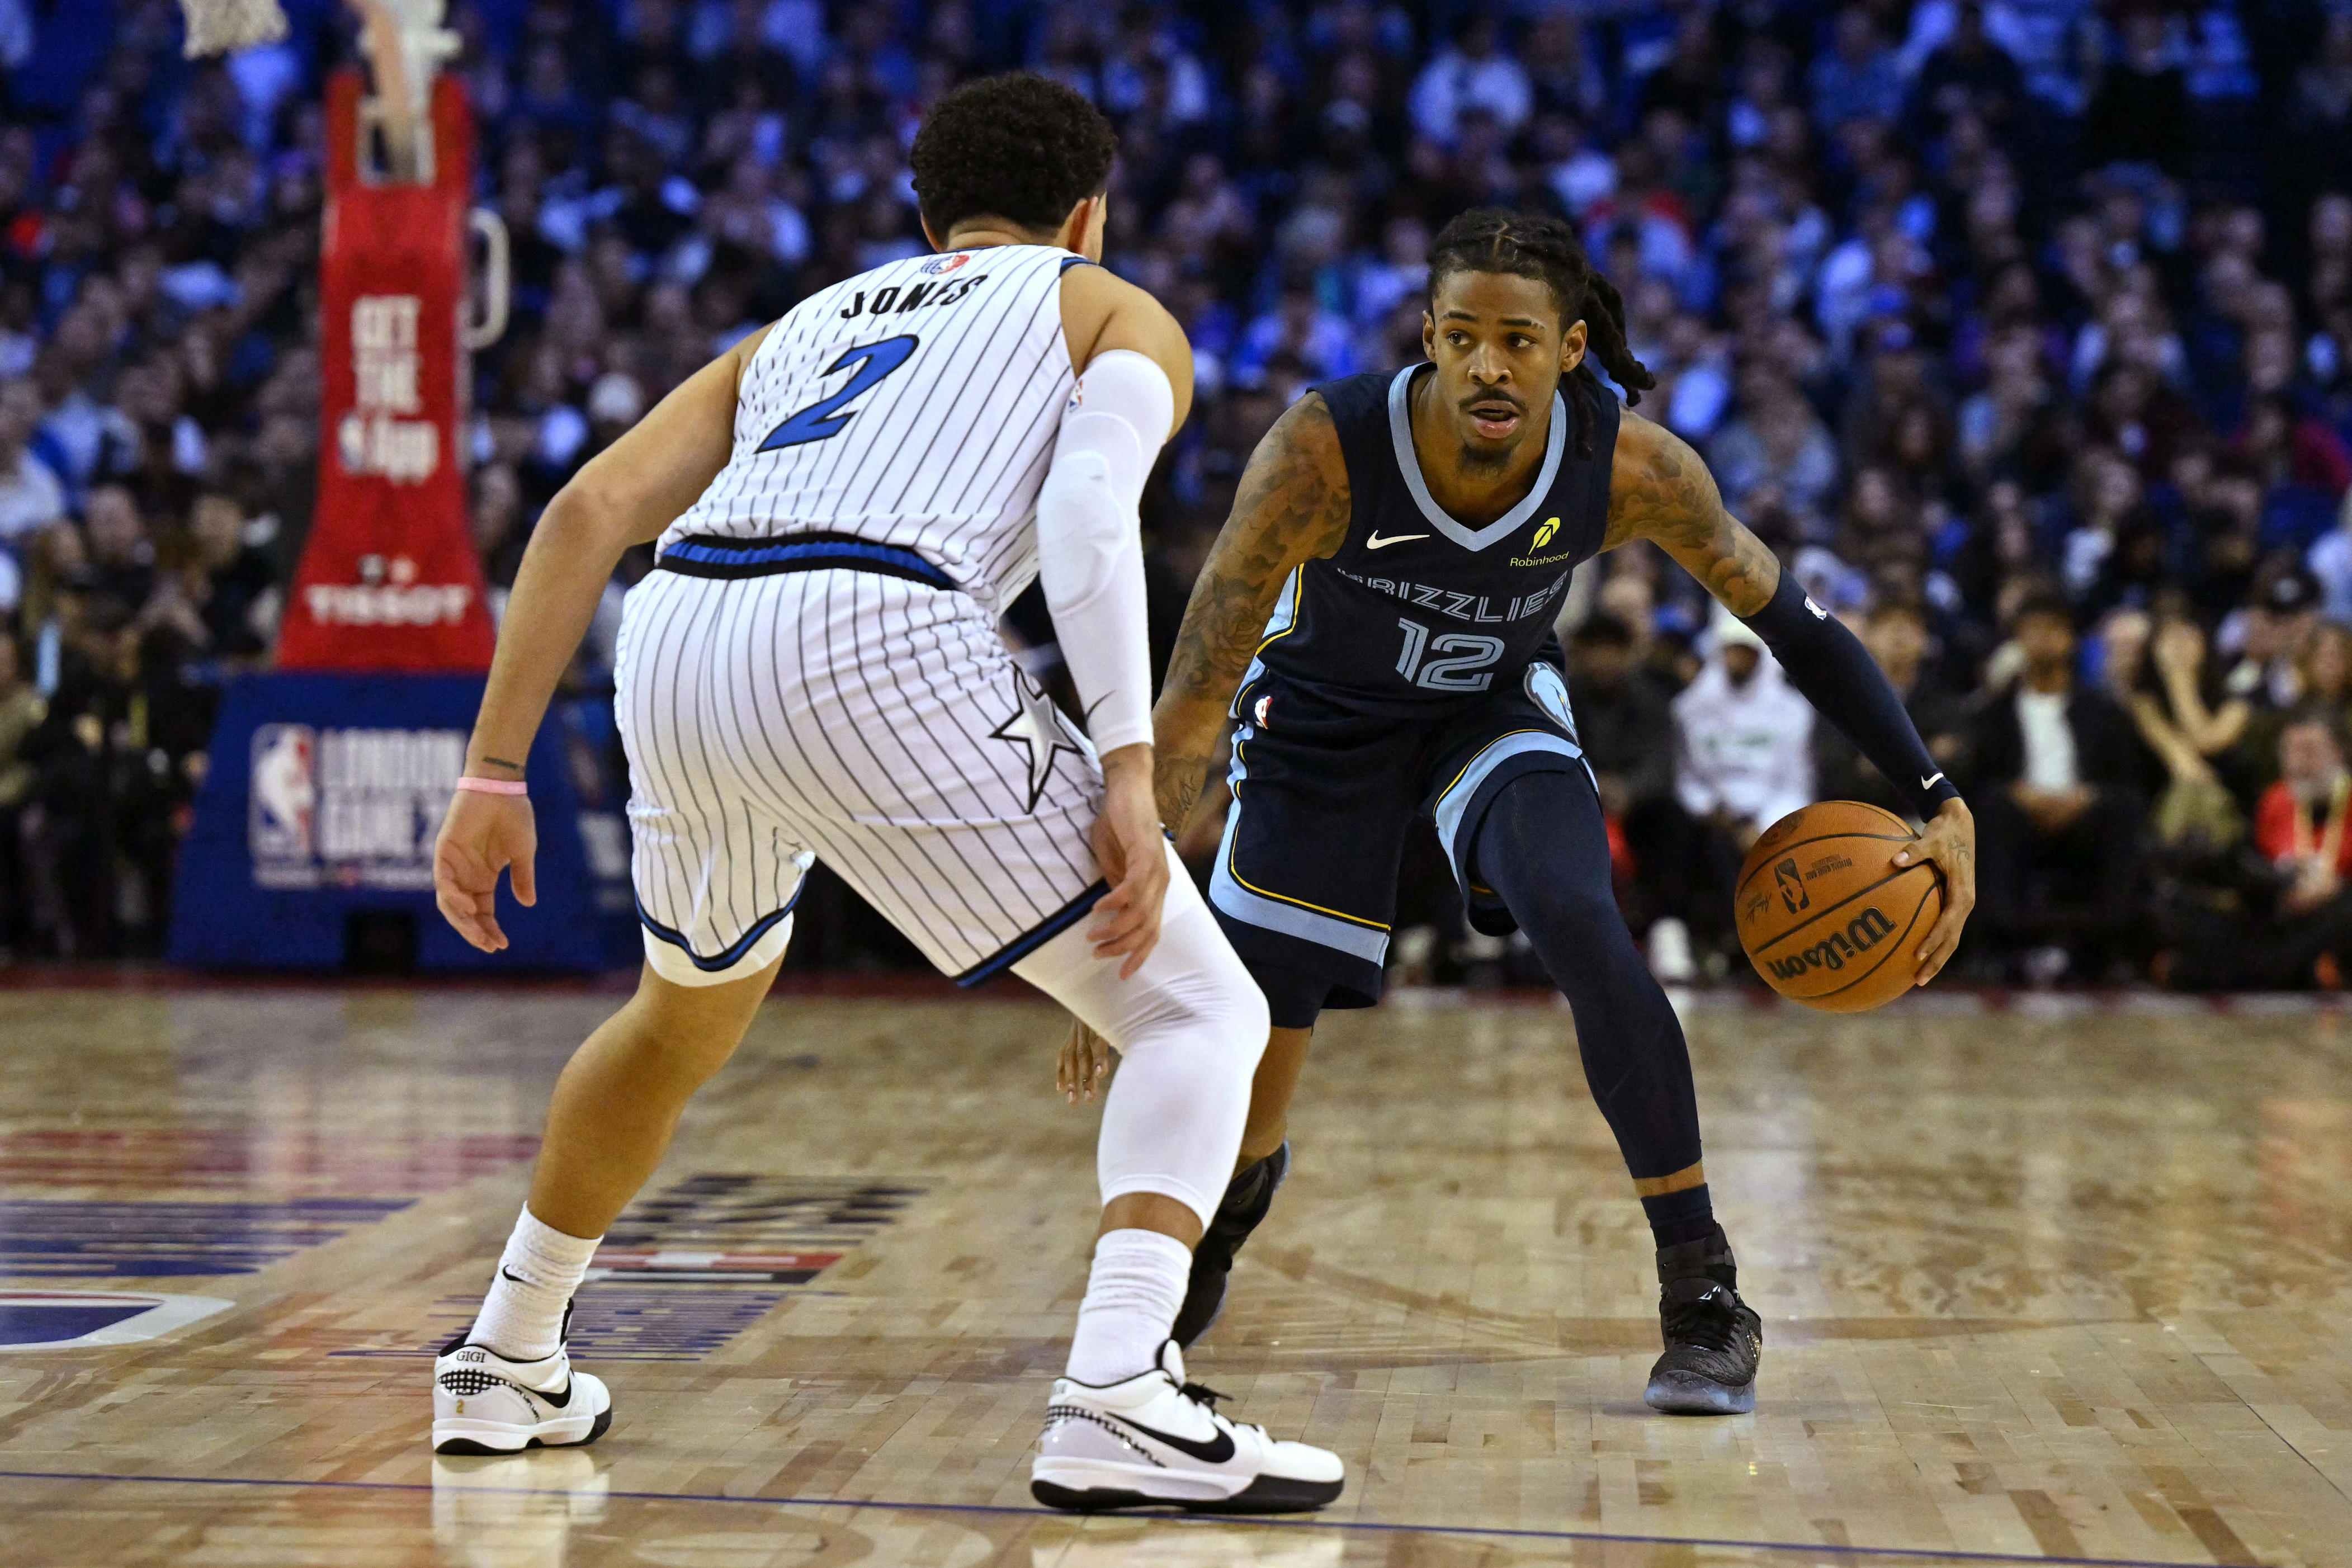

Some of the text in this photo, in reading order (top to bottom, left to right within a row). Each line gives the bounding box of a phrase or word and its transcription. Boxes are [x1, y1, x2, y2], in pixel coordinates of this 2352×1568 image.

[840, 275, 988, 319] JONES
[753, 334, 920, 455] 2
[1510, 551, 1569, 566] Robinhood
[1395, 617, 1505, 691] 12
[1765, 906, 1897, 981] Wilson
[456, 1350, 486, 1363] GIGI
